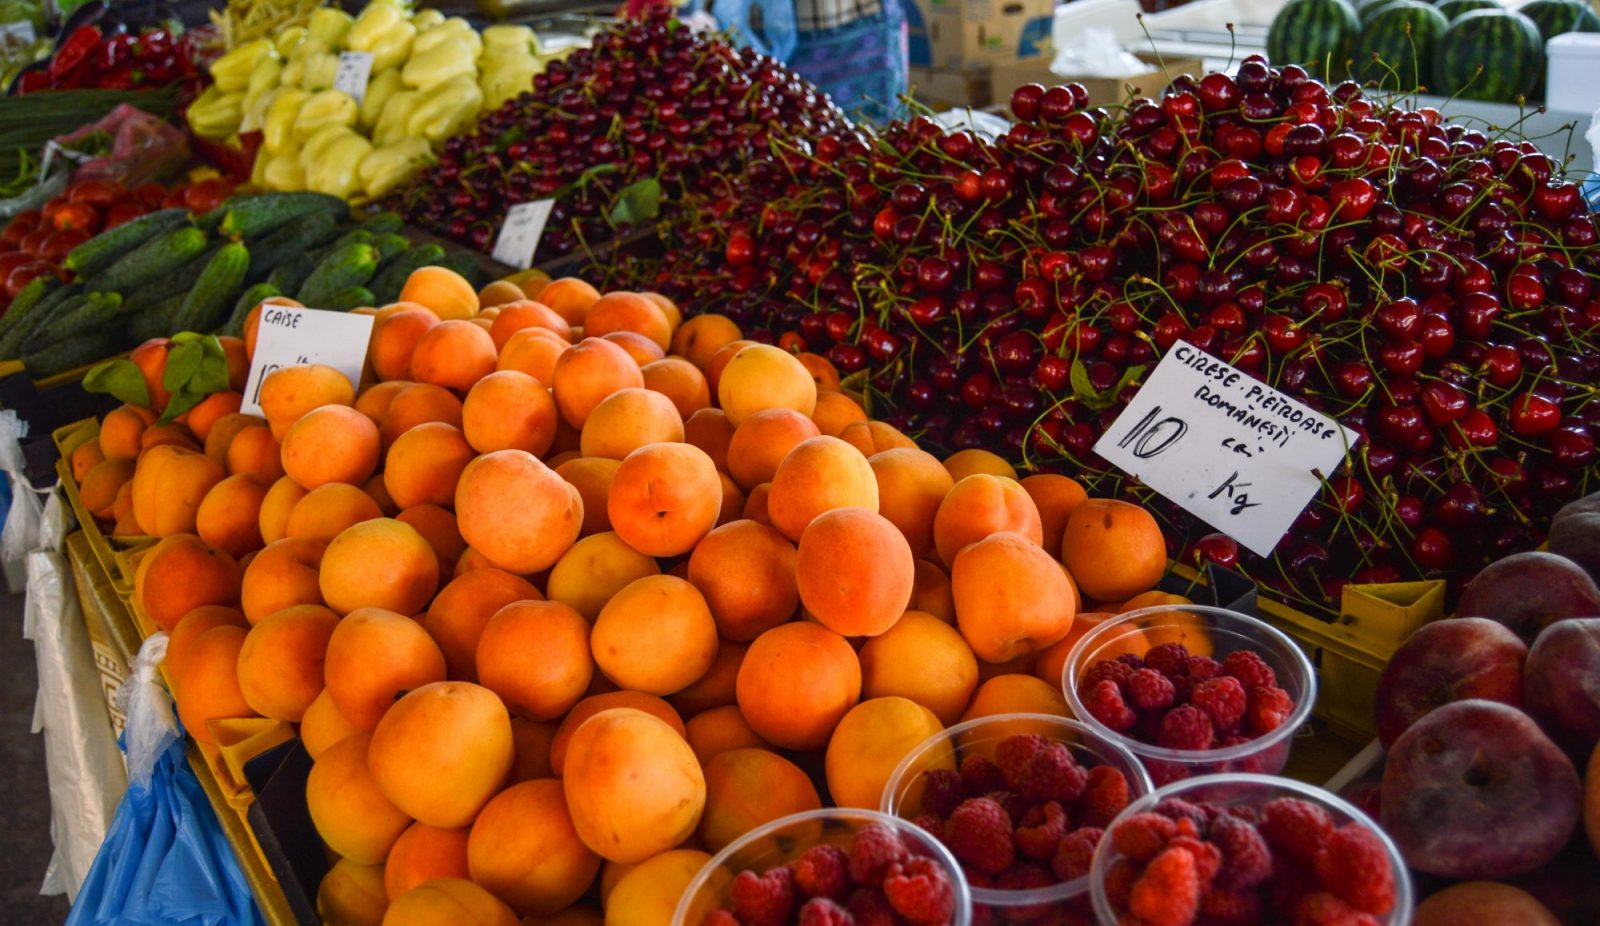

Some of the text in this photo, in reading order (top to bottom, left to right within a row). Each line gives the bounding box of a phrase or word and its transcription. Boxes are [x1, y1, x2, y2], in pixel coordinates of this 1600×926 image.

[264, 309, 302, 328] CAISE
[1118, 405, 1188, 459] 10
[1208, 471, 1262, 515] Kg
